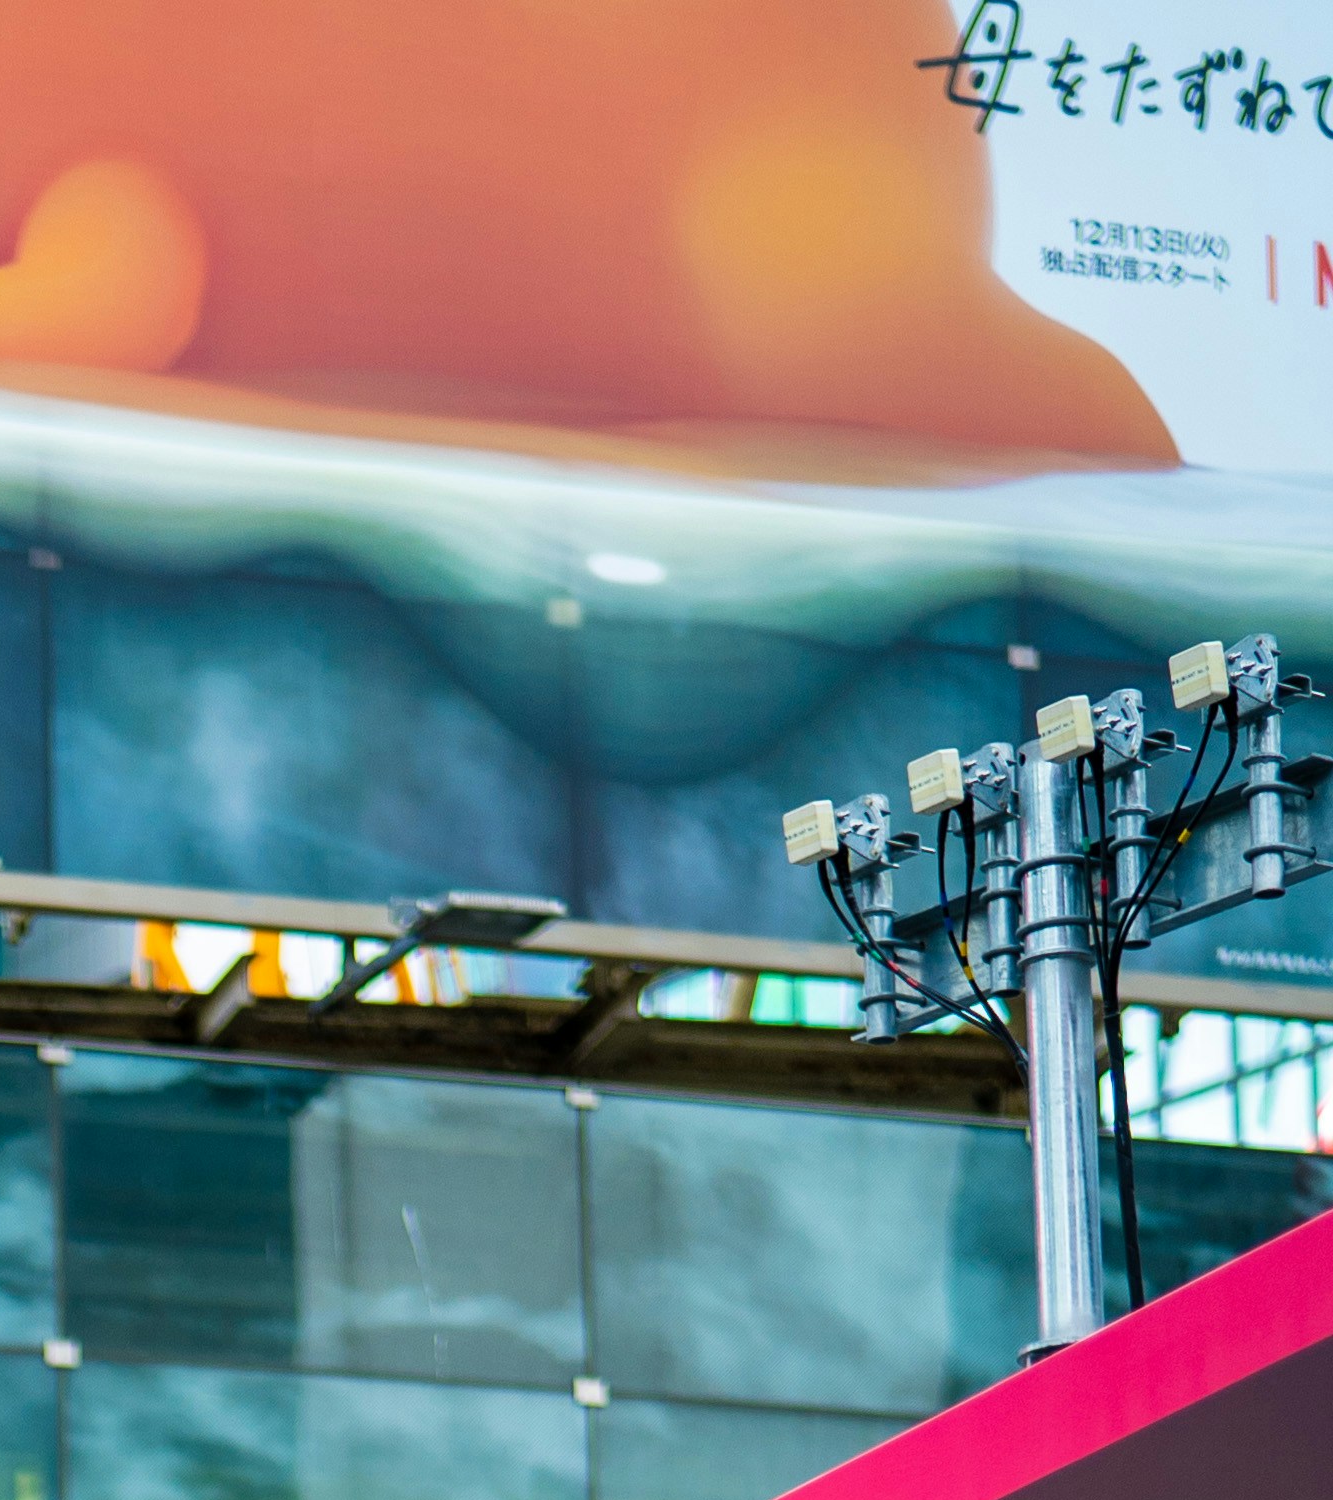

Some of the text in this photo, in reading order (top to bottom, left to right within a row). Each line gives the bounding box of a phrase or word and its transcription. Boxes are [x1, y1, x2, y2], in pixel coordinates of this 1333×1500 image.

[1040, 246, 1231, 292] 独占配信スタート
